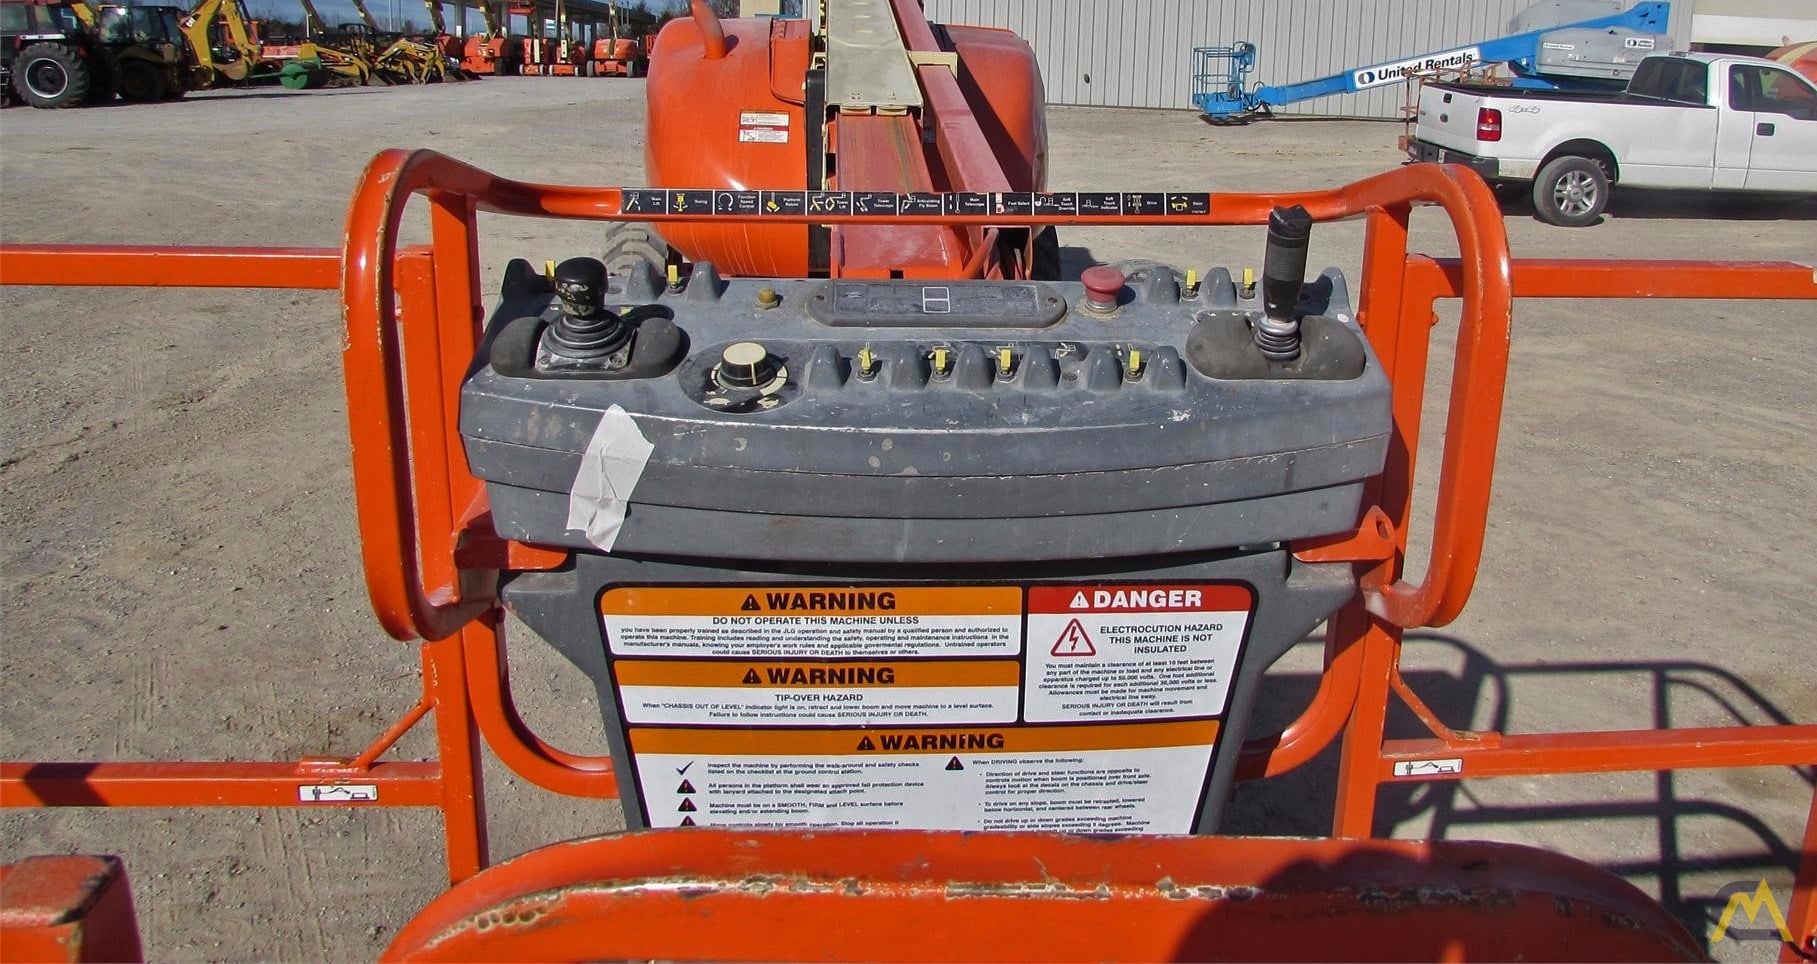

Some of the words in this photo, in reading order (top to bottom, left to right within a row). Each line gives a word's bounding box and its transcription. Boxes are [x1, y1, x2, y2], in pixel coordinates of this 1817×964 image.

[1425, 53, 1472, 70] Rentals
[766, 592, 896, 610] WARNING
[1094, 590, 1201, 608] DANGER
[829, 616, 876, 624] MACHINE
[1100, 624, 1181, 634] ELECTROCUTION
[1184, 623, 1223, 631] HAZARD
[1109, 636, 1131, 644] THIS
[1134, 634, 1178, 643] MACHINE
[1192, 633, 1212, 641] NOT
[1134, 646, 1187, 654] INSULATED
[766, 667, 895, 684] WARNING
[1110, 708, 1143, 716] inadequate
[880, 733, 1004, 750] WARNING
